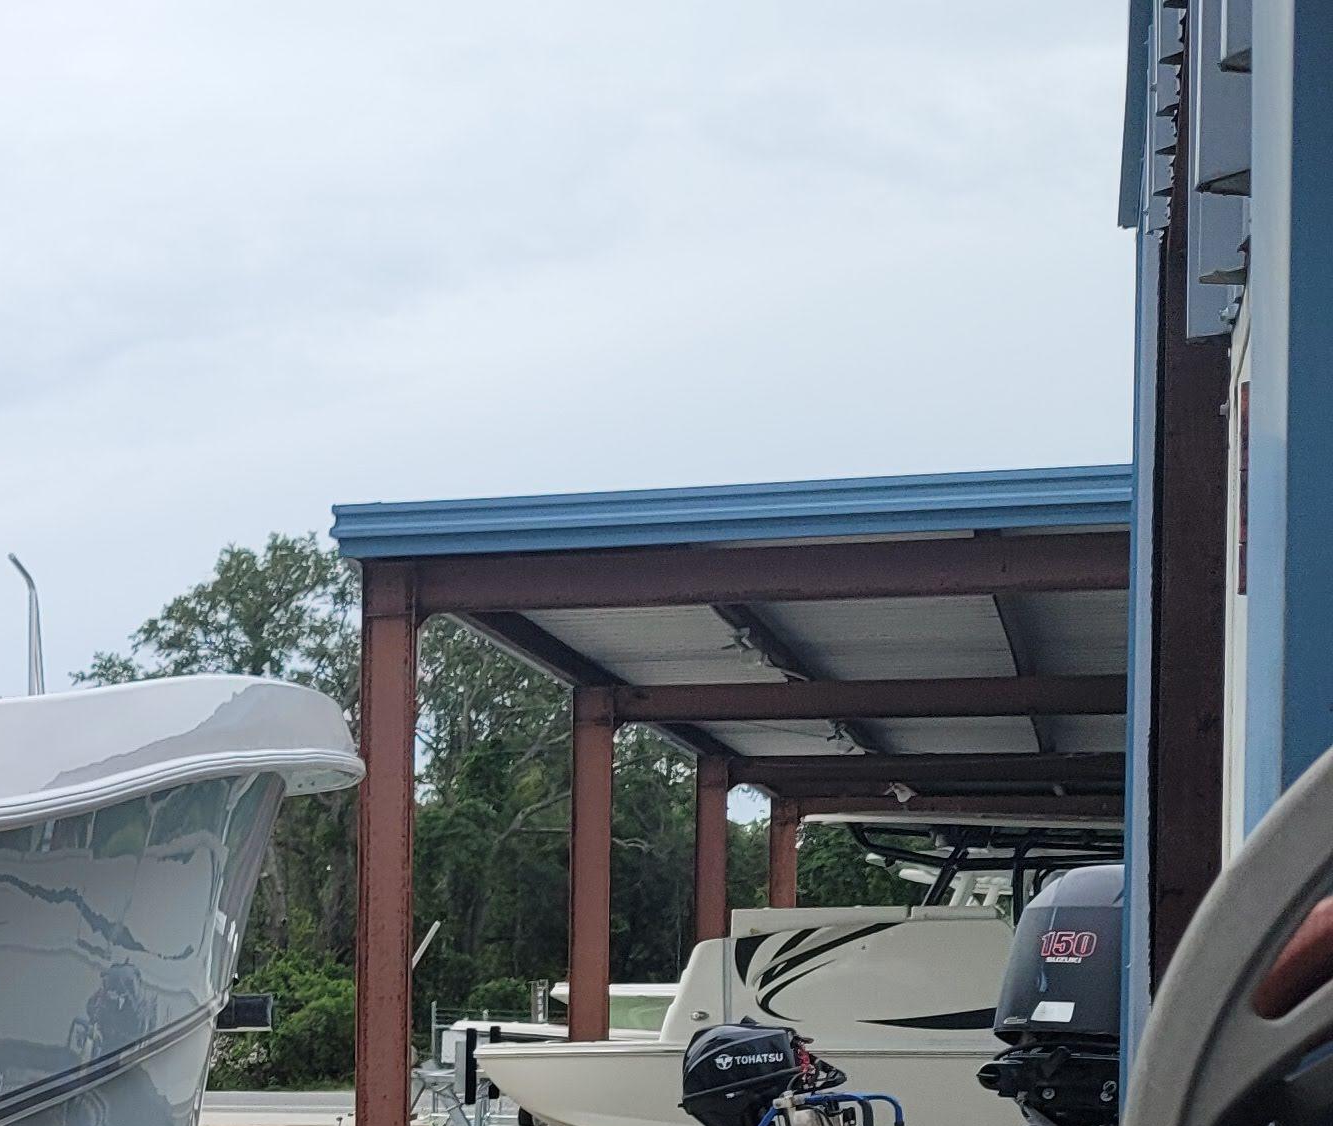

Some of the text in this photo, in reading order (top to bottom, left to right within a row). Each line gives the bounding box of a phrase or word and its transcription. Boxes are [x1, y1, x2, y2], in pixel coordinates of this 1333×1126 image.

[1040, 931, 1097, 958] 150
[1045, 956, 1082, 964] SUZUKI
[734, 1052, 784, 1065] TOHATSU
